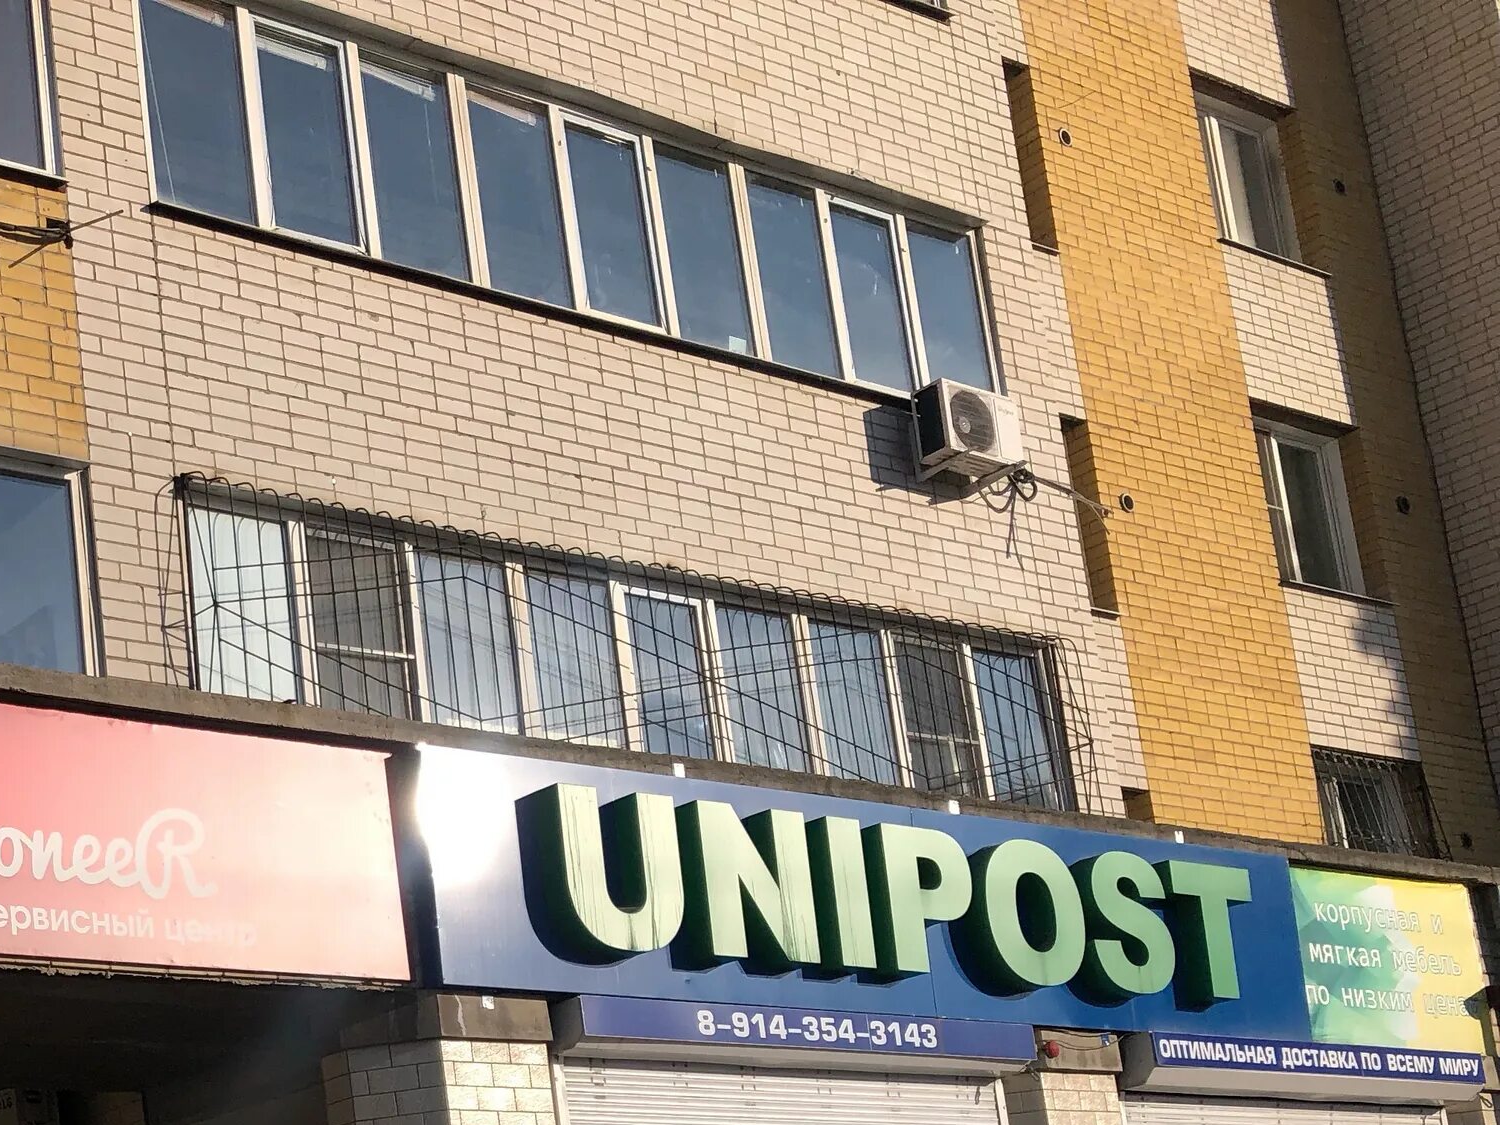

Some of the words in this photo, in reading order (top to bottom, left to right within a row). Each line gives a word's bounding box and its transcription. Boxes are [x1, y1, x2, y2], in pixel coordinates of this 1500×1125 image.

[520, 783, 1252, 1008] UNIPOST
[1313, 901, 1421, 934] корпусная
[1430, 914, 1443, 935] и
[1308, 942, 1382, 969] мягкая
[1391, 946, 1463, 977] мебель
[1305, 984, 1330, 1006] по
[1343, 986, 1415, 1013] низким
[1422, 993, 1471, 1019] цена
[697, 1009, 938, 1049] 8-914-354-3143
[1159, 1038, 1277, 1065] ОПТИМАЛЬНАЯ
[1282, 1047, 1357, 1070] ДОСТАВКА
[1361, 1053, 1382, 1071] ПО
[1387, 1054, 1435, 1074] ВСЕМУ
[1439, 1057, 1480, 1077] МИРУ
